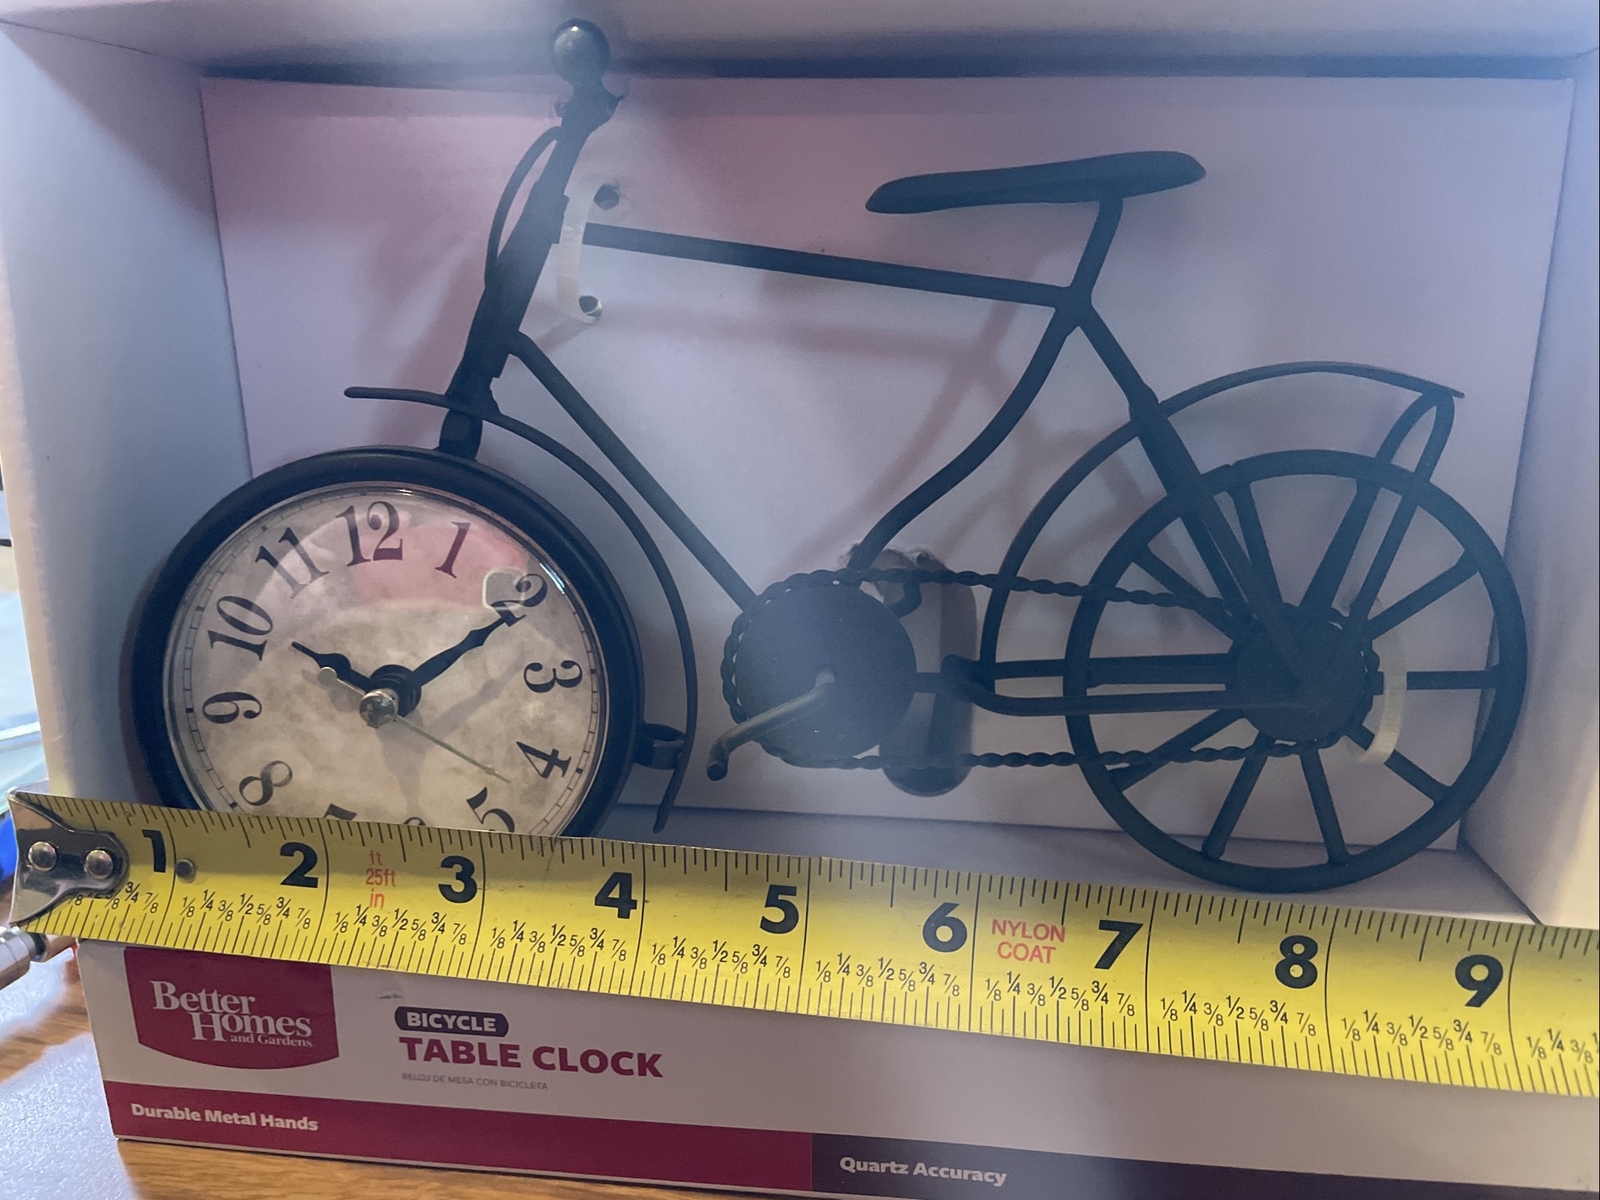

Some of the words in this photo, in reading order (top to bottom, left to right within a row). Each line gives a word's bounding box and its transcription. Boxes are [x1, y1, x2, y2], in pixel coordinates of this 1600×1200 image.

[335, 501, 404, 567] 12
[435, 521, 471, 579] 1
[255, 526, 329, 598] 11
[491, 573, 548, 628] 2
[206, 595, 274, 661] 10
[523, 660, 584, 693] 3
[202, 691, 263, 724] 9
[516, 741, 572, 780] 4
[238, 760, 294, 806] 8
[466, 787, 516, 834] 5
[142, 829, 167, 873] 1
[279, 842, 318, 888] 2
[369, 850, 382, 866] ft
[365, 868, 396, 887] 25ft
[369, 888, 385, 909] in
[438, 855, 478, 904] 3
[594, 871, 638, 919] 4
[759, 884, 800, 935] 5
[922, 901, 968, 953] 6
[991, 918, 1066, 943] NYLON
[996, 941, 1057, 964] COAT
[1094, 919, 1144, 971] 7
[1275, 934, 1318, 989] 8
[149, 980, 256, 1014] Better
[1454, 954, 1504, 1008] 9
[187, 1012, 312, 1042] Homes
[230, 1034, 254, 1044] and
[406, 1011, 497, 1032] BICYCLE
[399, 1036, 522, 1068] TABLE
[532, 1046, 664, 1078] CLOCK
[402, 1072, 431, 1083] RELOJ
[433, 1074, 446, 1083] DE
[448, 1075, 474, 1085] MESA
[476, 1077, 498, 1086] CON
[500, 1079, 548, 1090] BICICLETA
[130, 1103, 201, 1121] Durable
[204, 1109, 257, 1126] Metal
[261, 1113, 319, 1131] Hands
[839, 1156, 909, 1175] Quartz
[913, 1162, 1007, 1187] Accuracy
